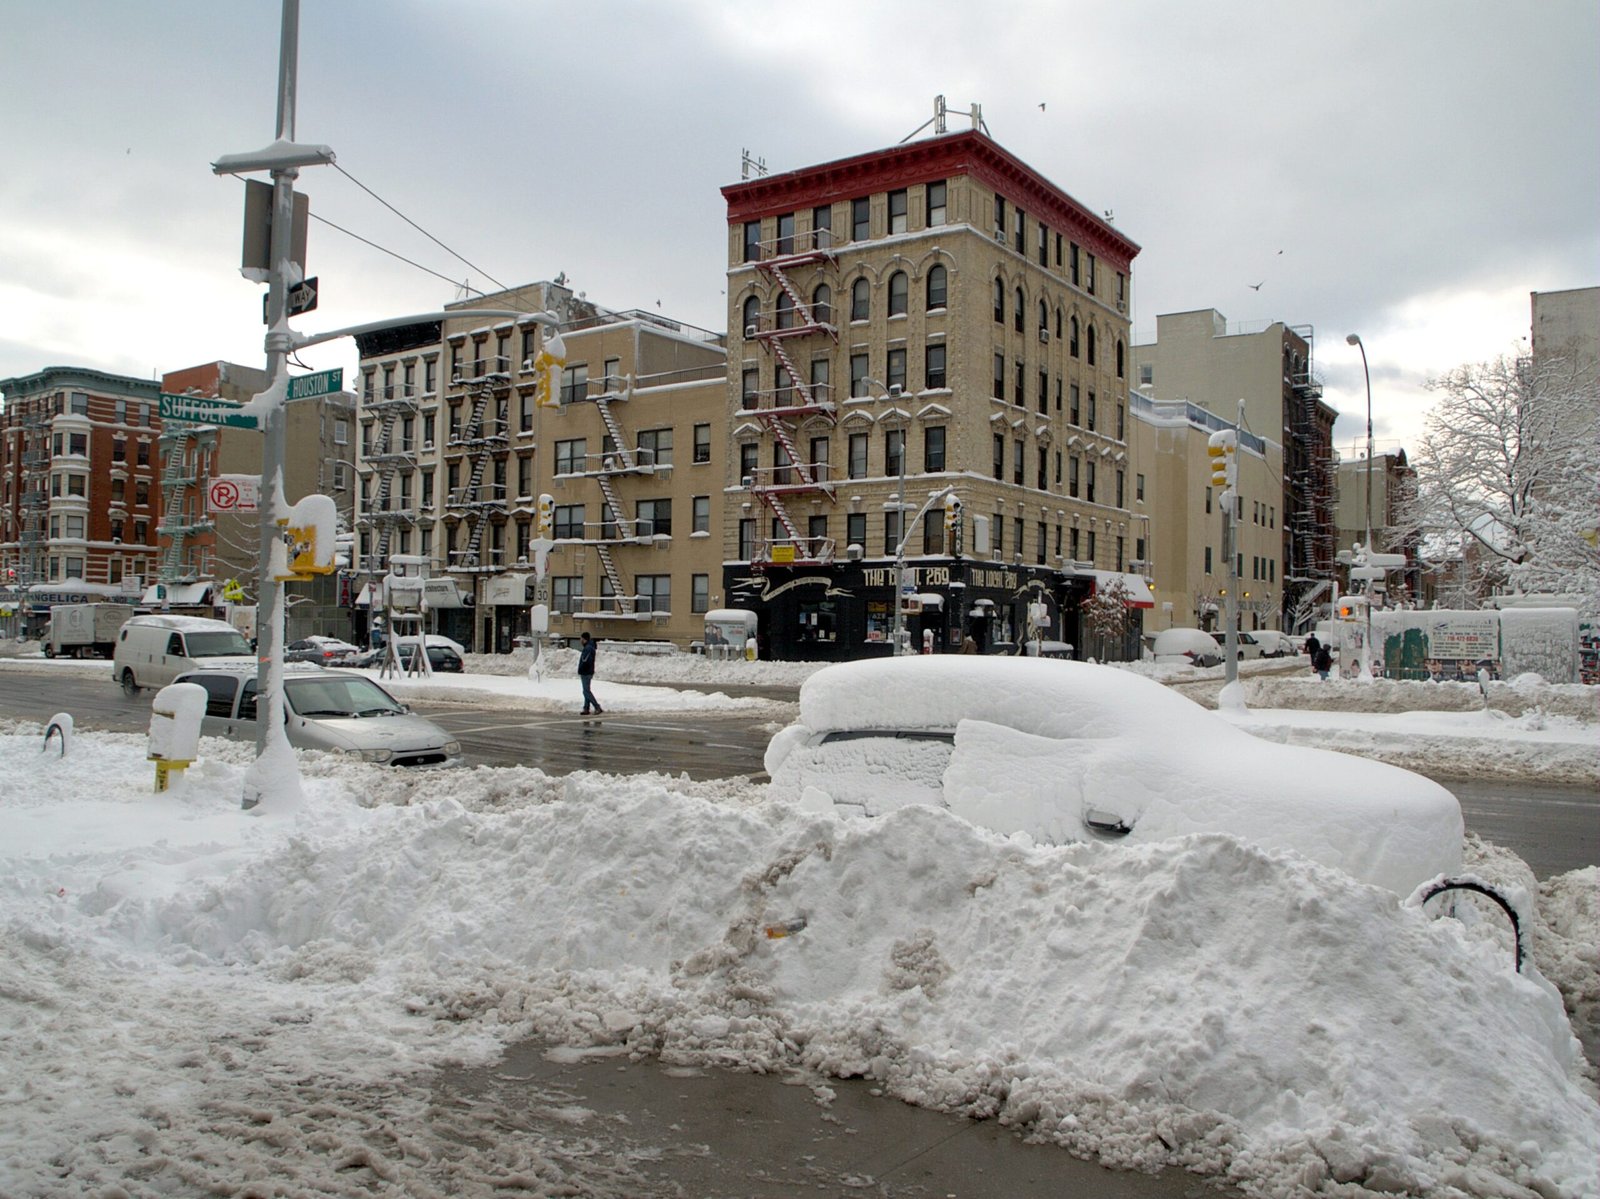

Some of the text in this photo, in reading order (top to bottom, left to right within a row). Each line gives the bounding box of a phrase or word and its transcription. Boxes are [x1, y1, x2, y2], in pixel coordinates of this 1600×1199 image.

[294, 289, 310, 305] WAY
[293, 373, 329, 398] HOUSTON
[332, 370, 341, 383] ST
[162, 396, 228, 423] SUFFOLK
[926, 567, 949, 585] 269
[1004, 571, 1018, 590] 269
[341, 577, 350, 606] TAX
[537, 590, 548, 601] 30
